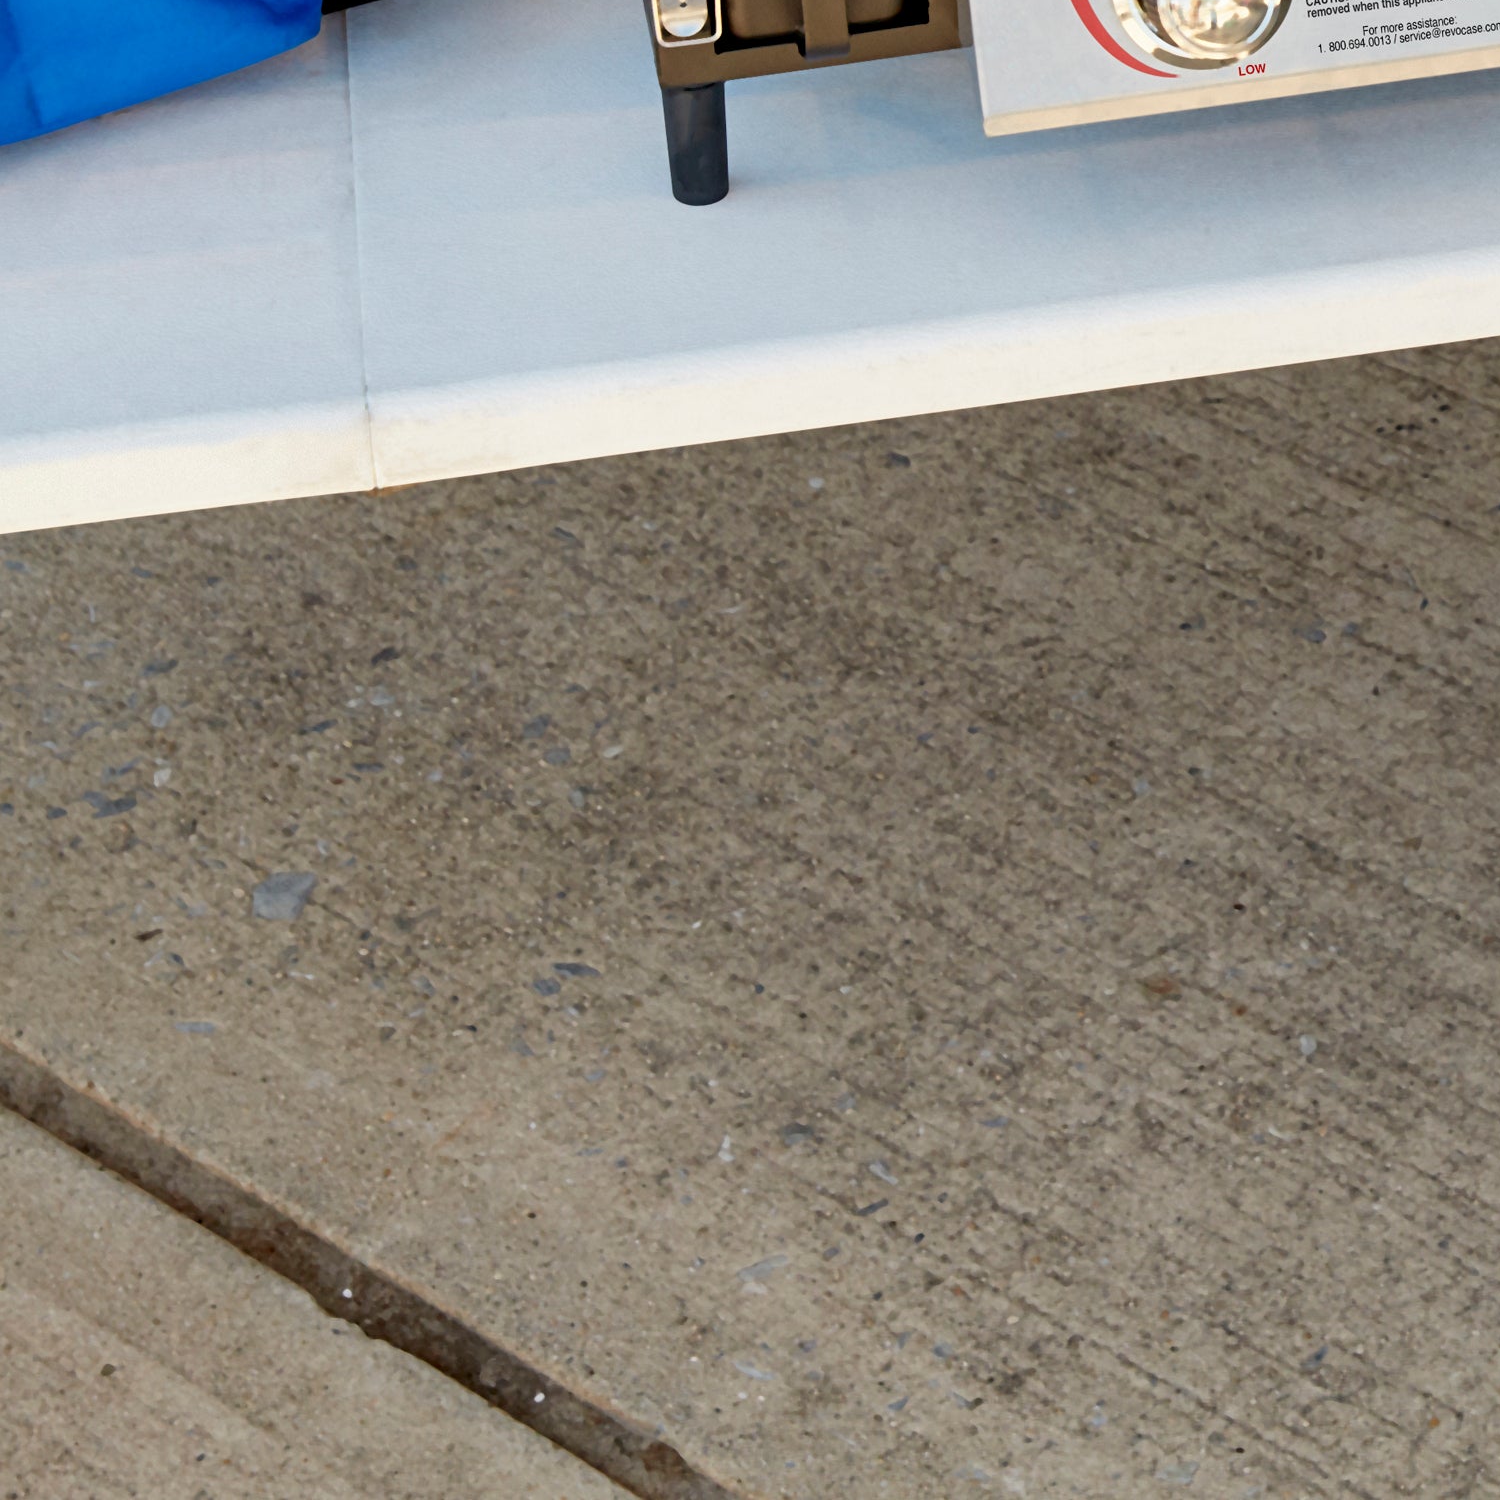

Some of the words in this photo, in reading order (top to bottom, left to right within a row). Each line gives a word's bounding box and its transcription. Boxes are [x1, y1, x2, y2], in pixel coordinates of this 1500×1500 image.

[1307, 3, 1350, 18] removed
[1352, 1, 1379, 12] when
[1362, 25, 1377, 36] For
[1380, 22, 1404, 34] more
[1406, 16, 1458, 31] assistance:
[1328, 34, 1391, 52] 800.694.0013
[1238, 63, 1266, 77] LOW
